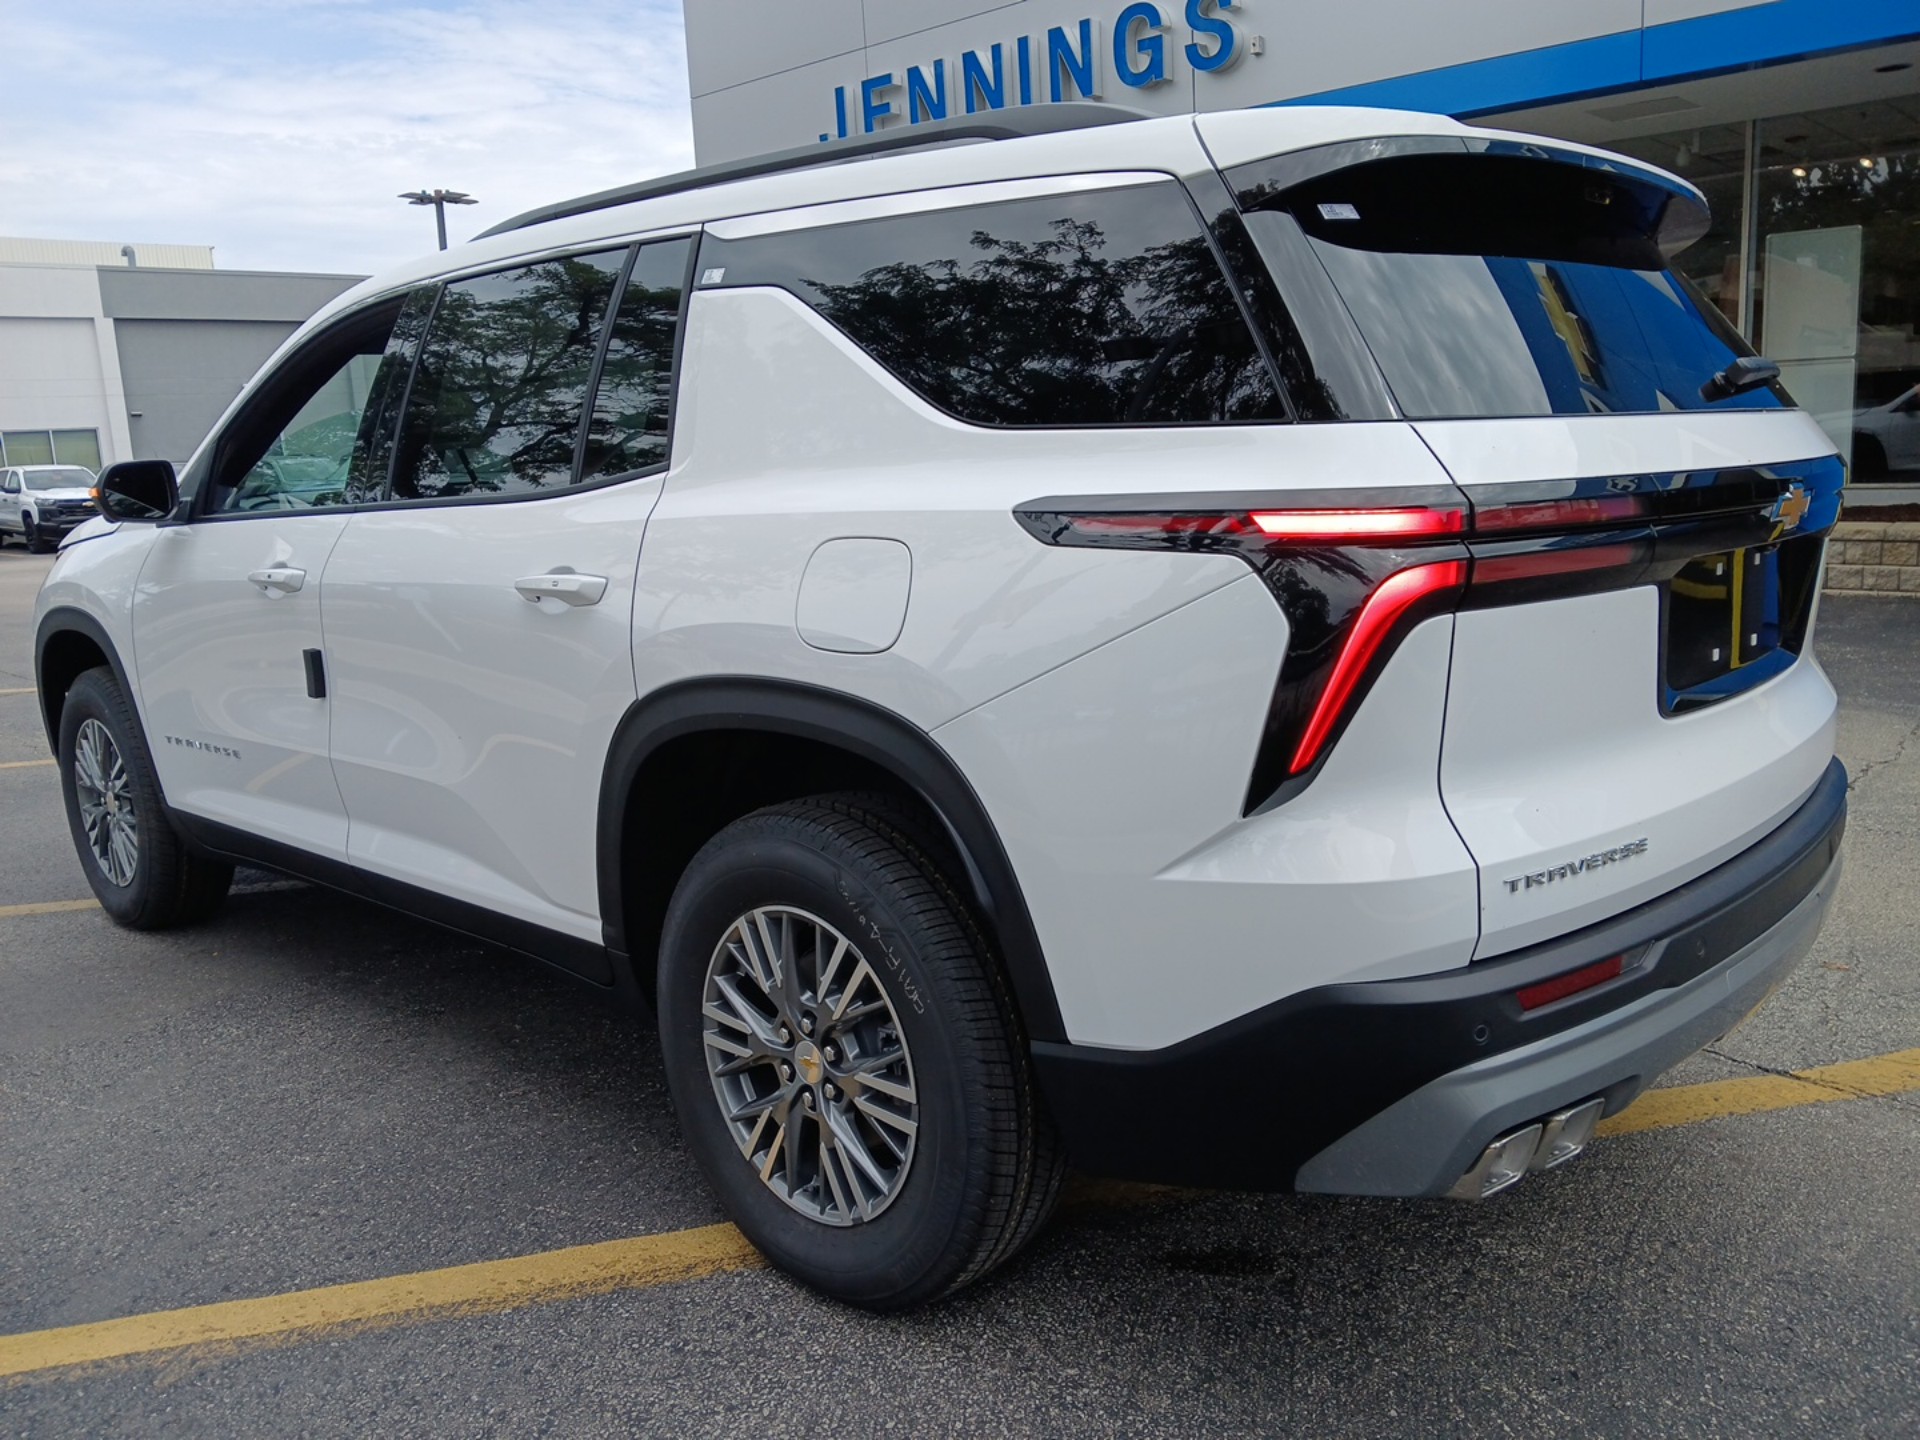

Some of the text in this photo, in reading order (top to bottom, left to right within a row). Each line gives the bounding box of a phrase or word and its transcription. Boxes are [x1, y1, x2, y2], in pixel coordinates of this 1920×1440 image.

[819, 0, 1238, 142] JENNINGS
[165, 735, 241, 760] TRAVERSE
[1502, 837, 1649, 893] TRAVERSE
